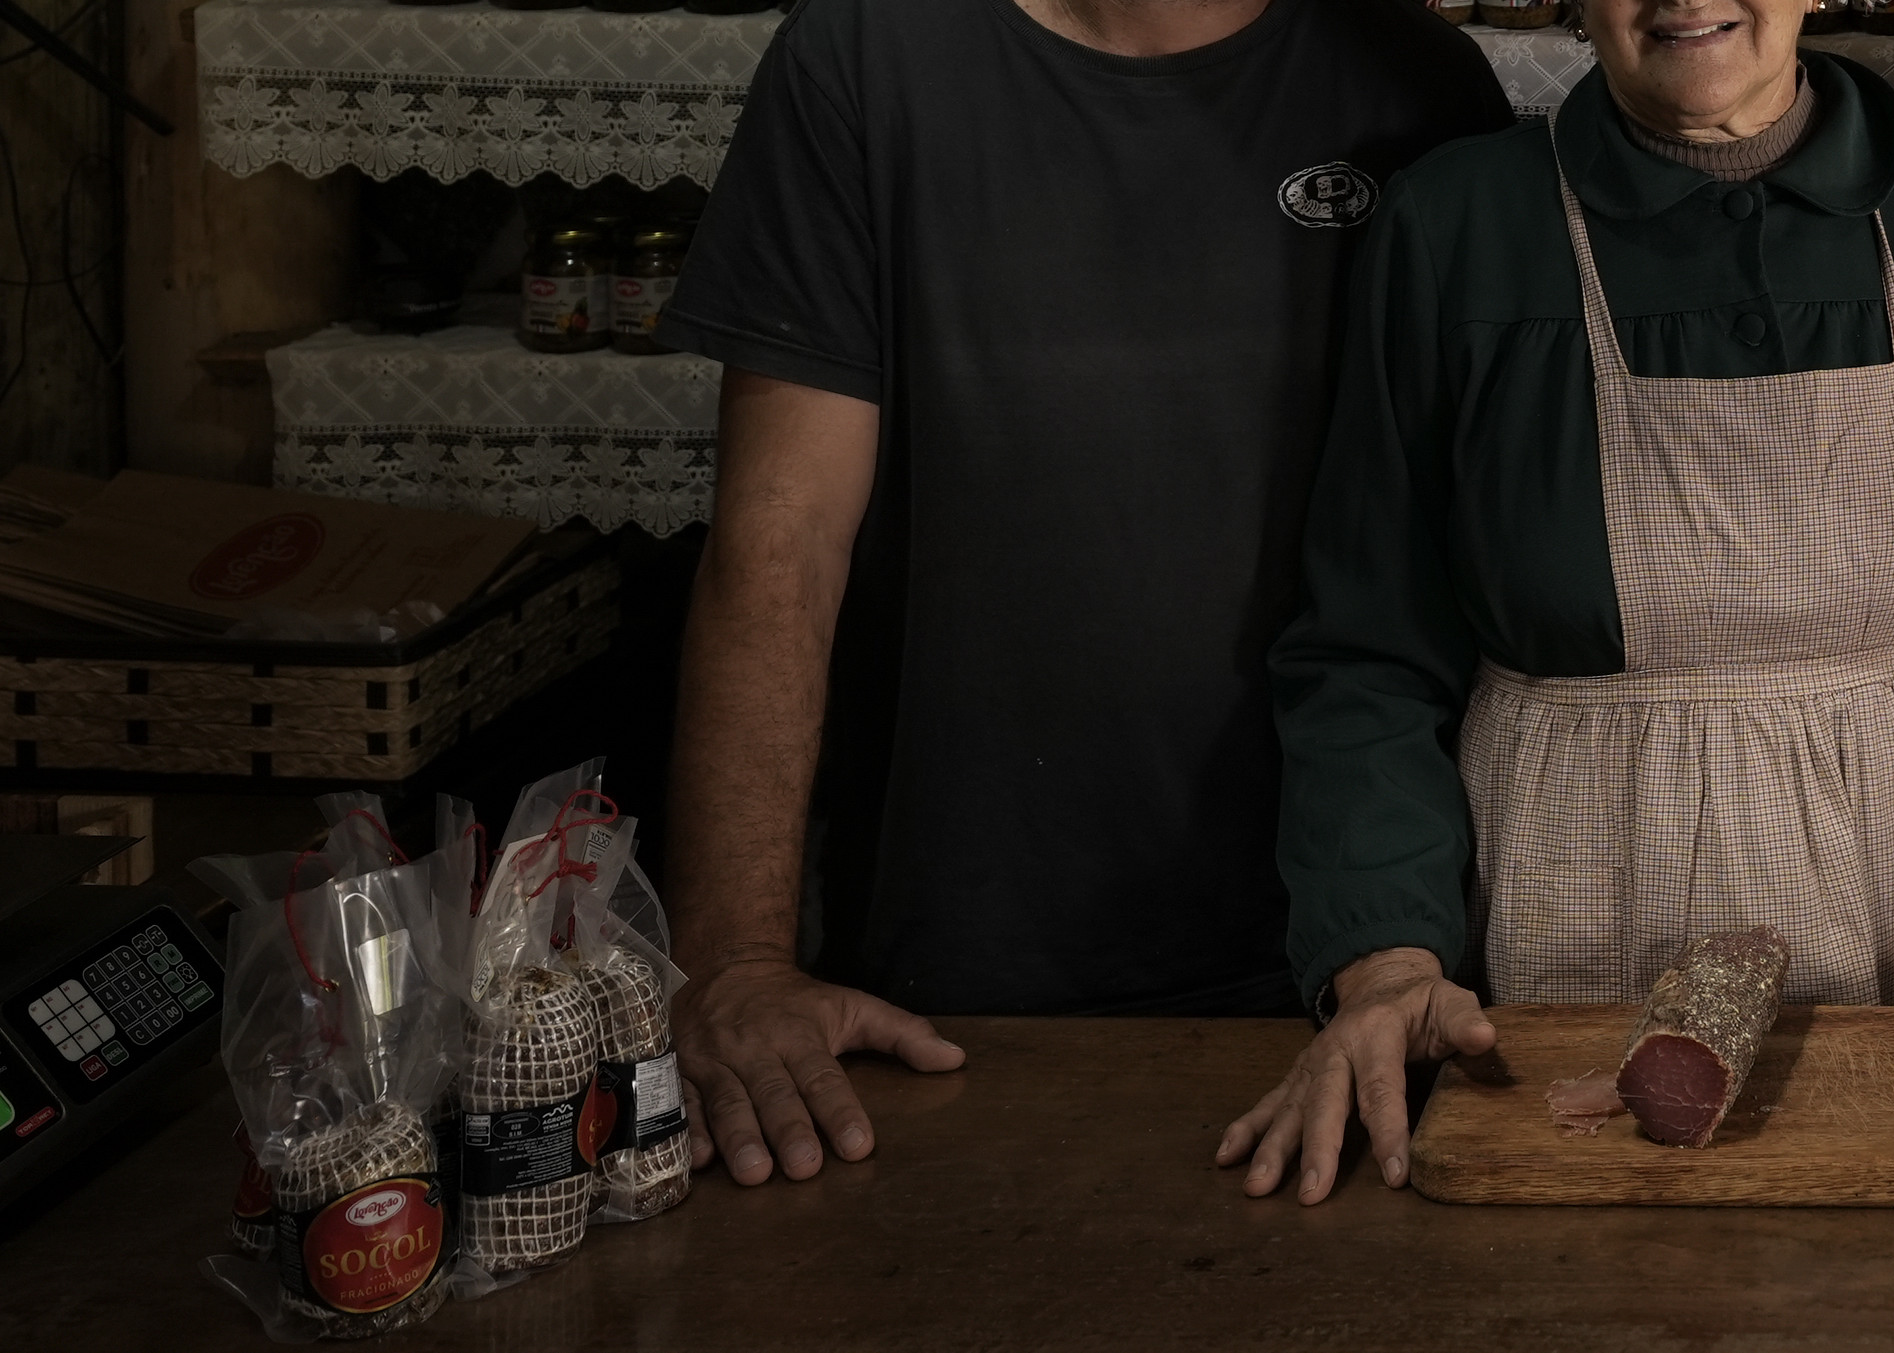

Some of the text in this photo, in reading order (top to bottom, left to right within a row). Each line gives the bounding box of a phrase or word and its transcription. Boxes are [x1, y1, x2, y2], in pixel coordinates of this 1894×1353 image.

[122, 951, 130, 961] 9
[106, 962, 114, 972] 8
[89, 972, 98, 983] 7
[139, 970, 146, 980] 6
[121, 981, 130, 991] 5
[105, 991, 113, 1001] 4
[153, 989, 162, 999] 3
[137, 1000, 146, 1010] 2
[121, 1011, 129, 1021] 1
[166, 1005, 179, 1019] 00
[152, 1019, 161, 1028] 0
[134, 1029, 144, 1040] C
[85, 1061, 102, 1075] LIGA
[354, 1197, 399, 1220] Lorenção
[319, 1225, 432, 1279] SOCOL
[340, 1268, 419, 1300] FRACIONADO
